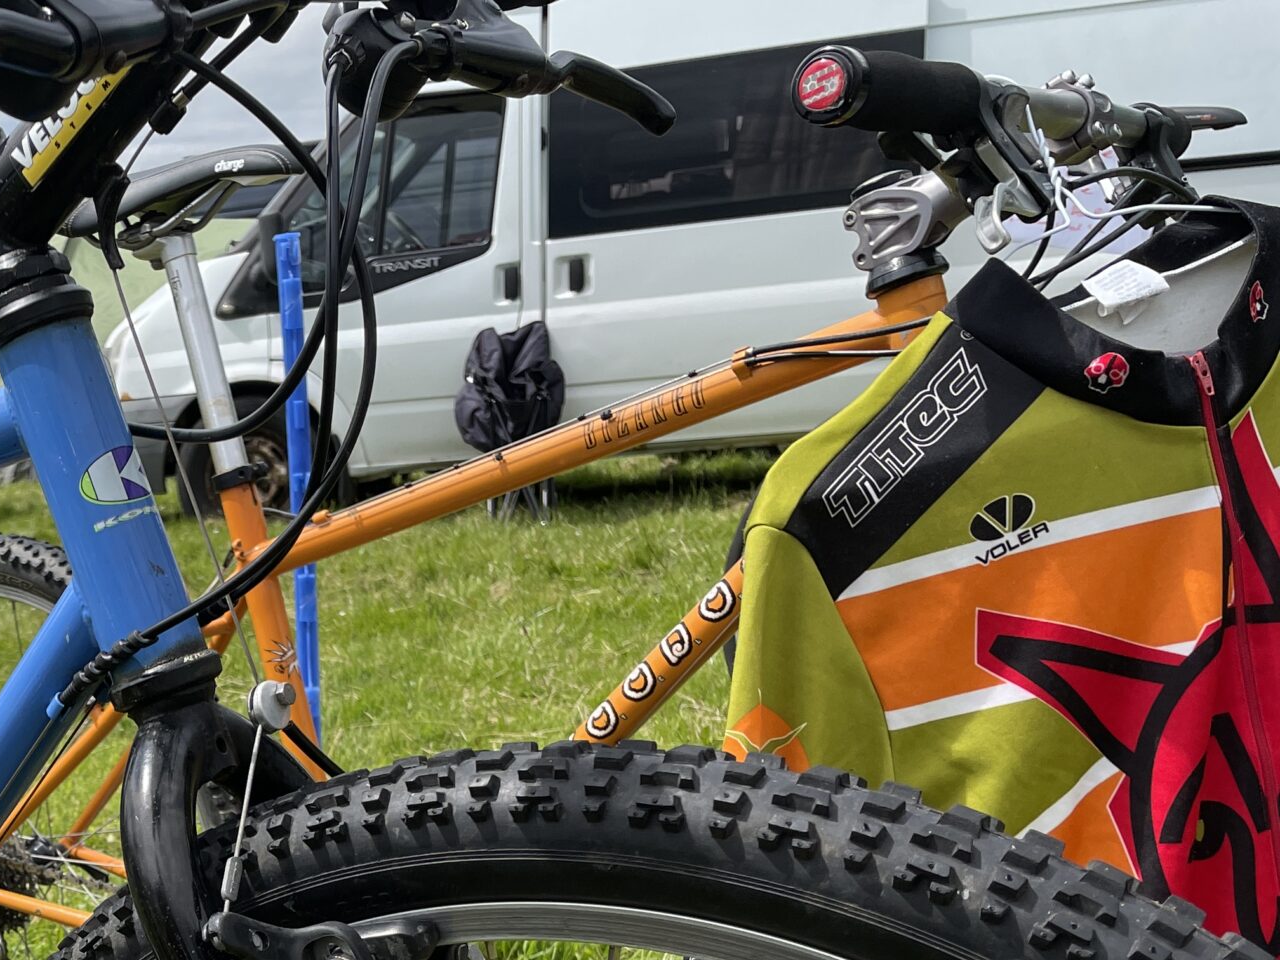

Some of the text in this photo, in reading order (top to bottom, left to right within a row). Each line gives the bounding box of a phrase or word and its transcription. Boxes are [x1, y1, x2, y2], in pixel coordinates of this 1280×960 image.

[214, 158, 245, 172] charge
[370, 256, 441, 274] TRANSIT
[583, 380, 706, 449] BIZANGO
